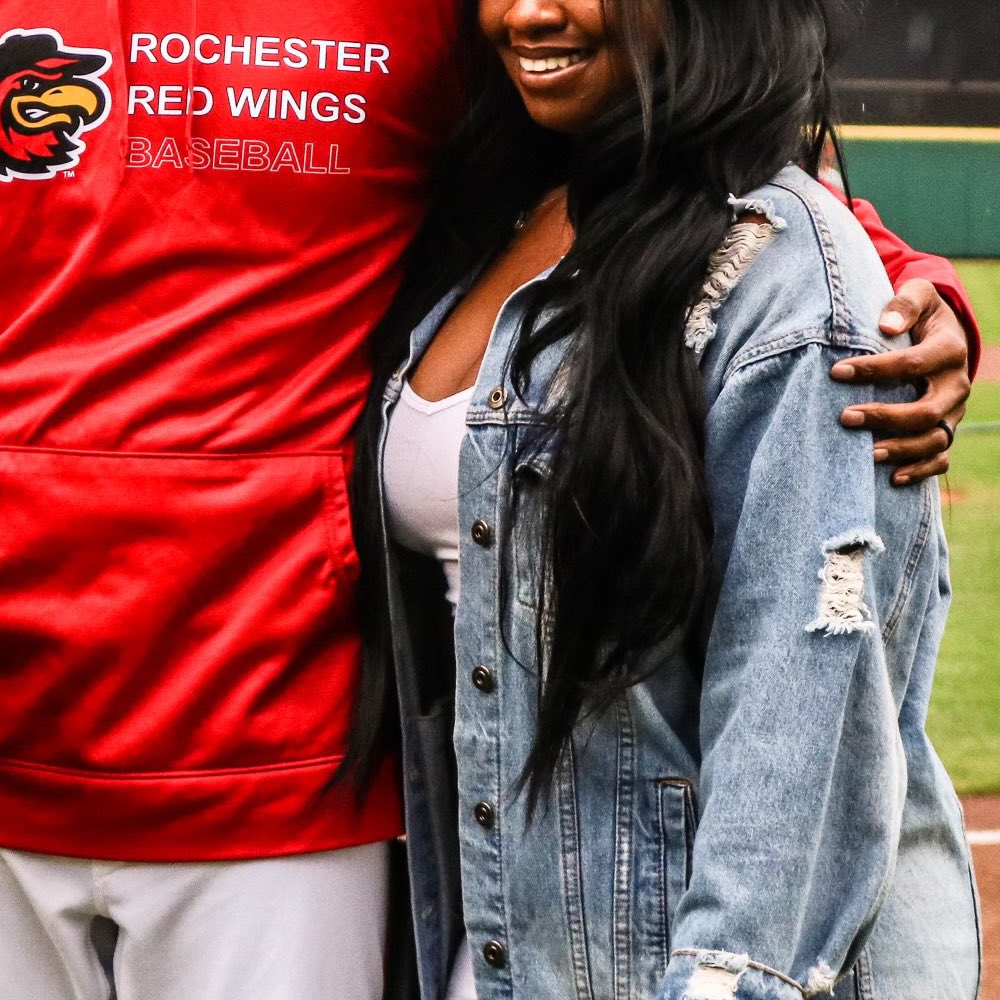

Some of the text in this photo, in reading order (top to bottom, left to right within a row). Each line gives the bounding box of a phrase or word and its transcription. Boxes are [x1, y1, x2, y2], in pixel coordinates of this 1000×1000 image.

[129, 33, 390, 75] ROCHESTER
[128, 85, 367, 124] RED WINGS
[124, 137, 351, 175] BASEBALL
